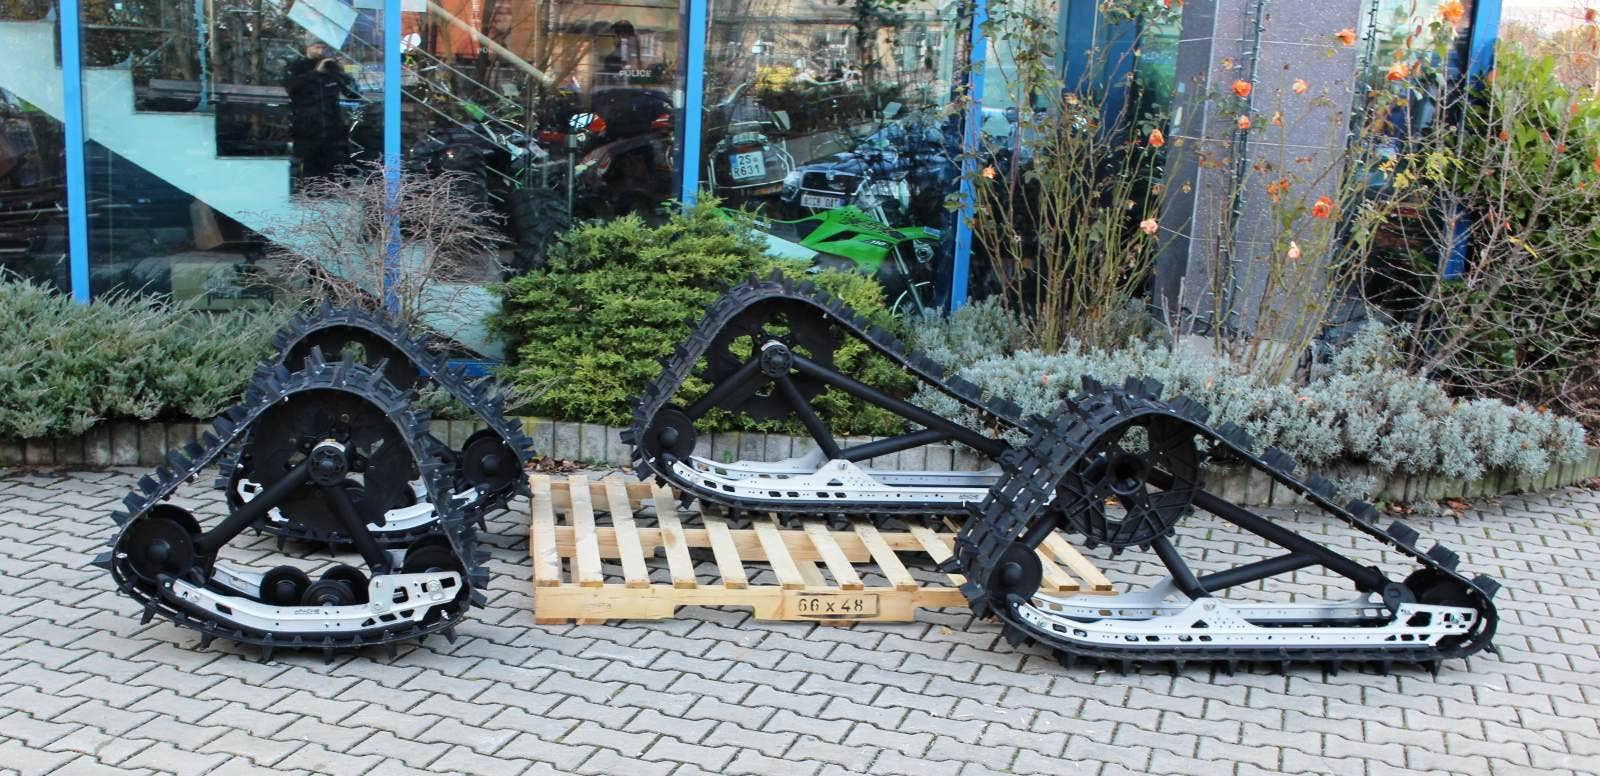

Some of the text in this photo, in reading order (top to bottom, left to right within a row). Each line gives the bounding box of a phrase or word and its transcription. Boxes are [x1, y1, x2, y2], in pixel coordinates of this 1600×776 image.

[619, 69, 652, 77] POLICE
[798, 598, 863, 612] 66 x 48
